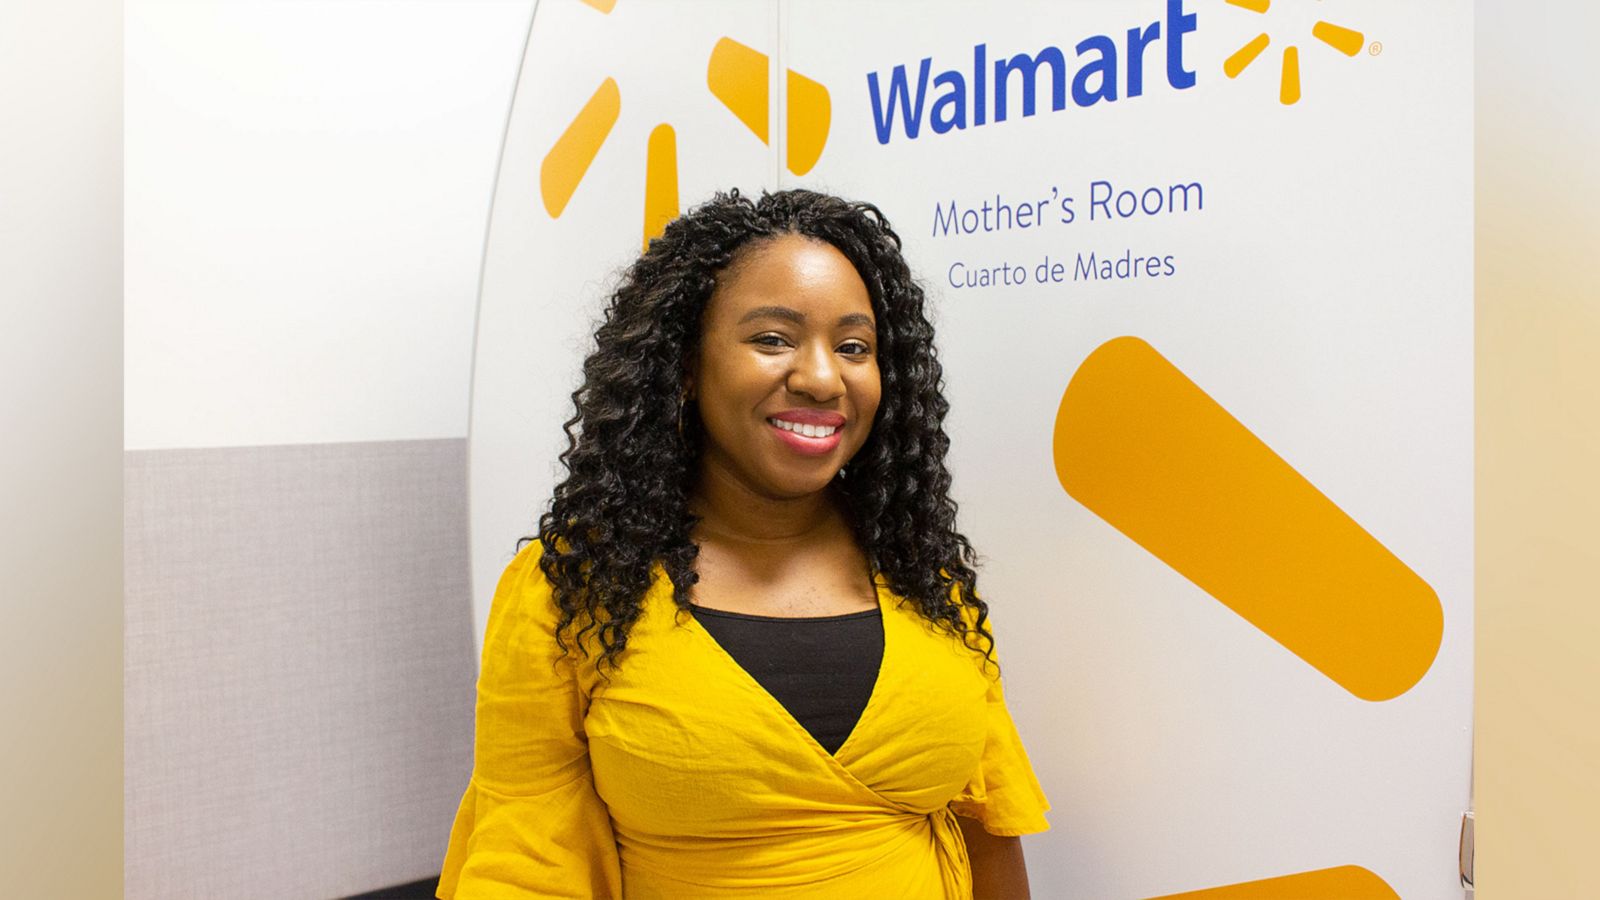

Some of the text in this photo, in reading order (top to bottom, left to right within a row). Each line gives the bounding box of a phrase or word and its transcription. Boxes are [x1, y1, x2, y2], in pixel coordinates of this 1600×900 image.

[866, 0, 1198, 145] Walmart
[932, 180, 1204, 238] Mother’s Room
[948, 250, 1176, 289] Cuarto de Madres
